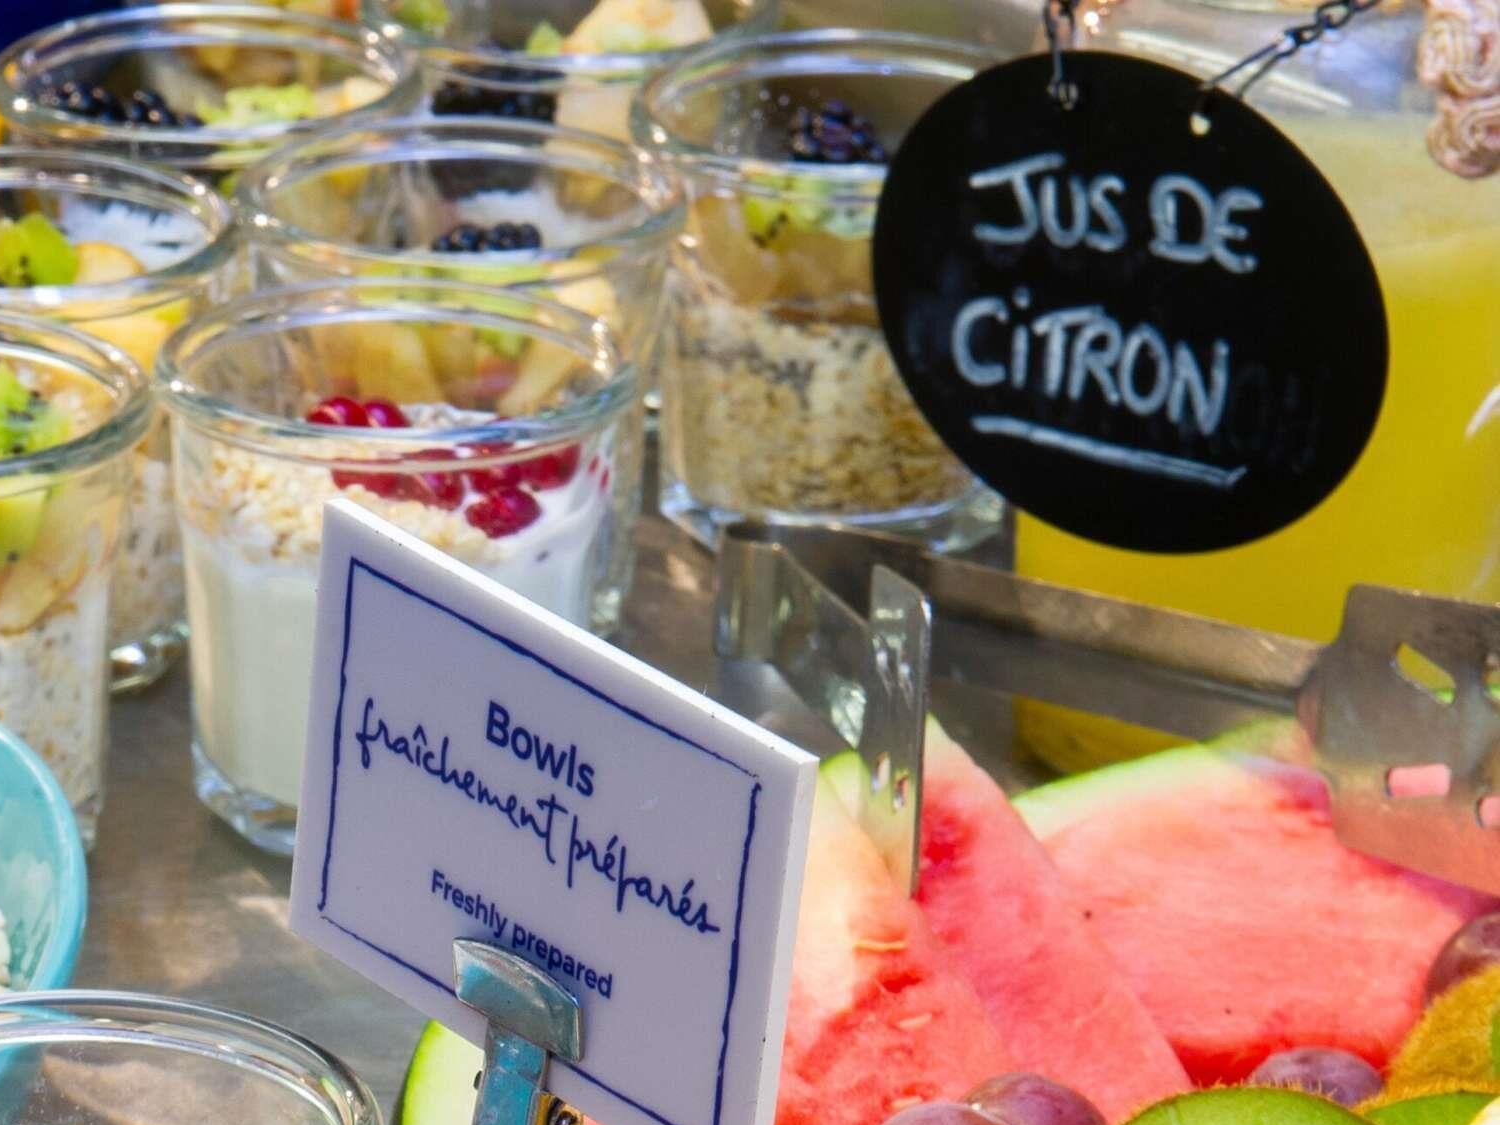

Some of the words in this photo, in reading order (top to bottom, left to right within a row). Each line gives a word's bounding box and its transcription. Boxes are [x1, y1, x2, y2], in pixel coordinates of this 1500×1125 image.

[970, 153, 1126, 251] JUS
[1149, 174, 1263, 273] DE
[485, 702, 594, 796] Bowls
[355, 698, 568, 864] fraîchement
[567, 815, 720, 934] préparés
[432, 870, 507, 938] Freshly
[513, 924, 613, 999] prepared
